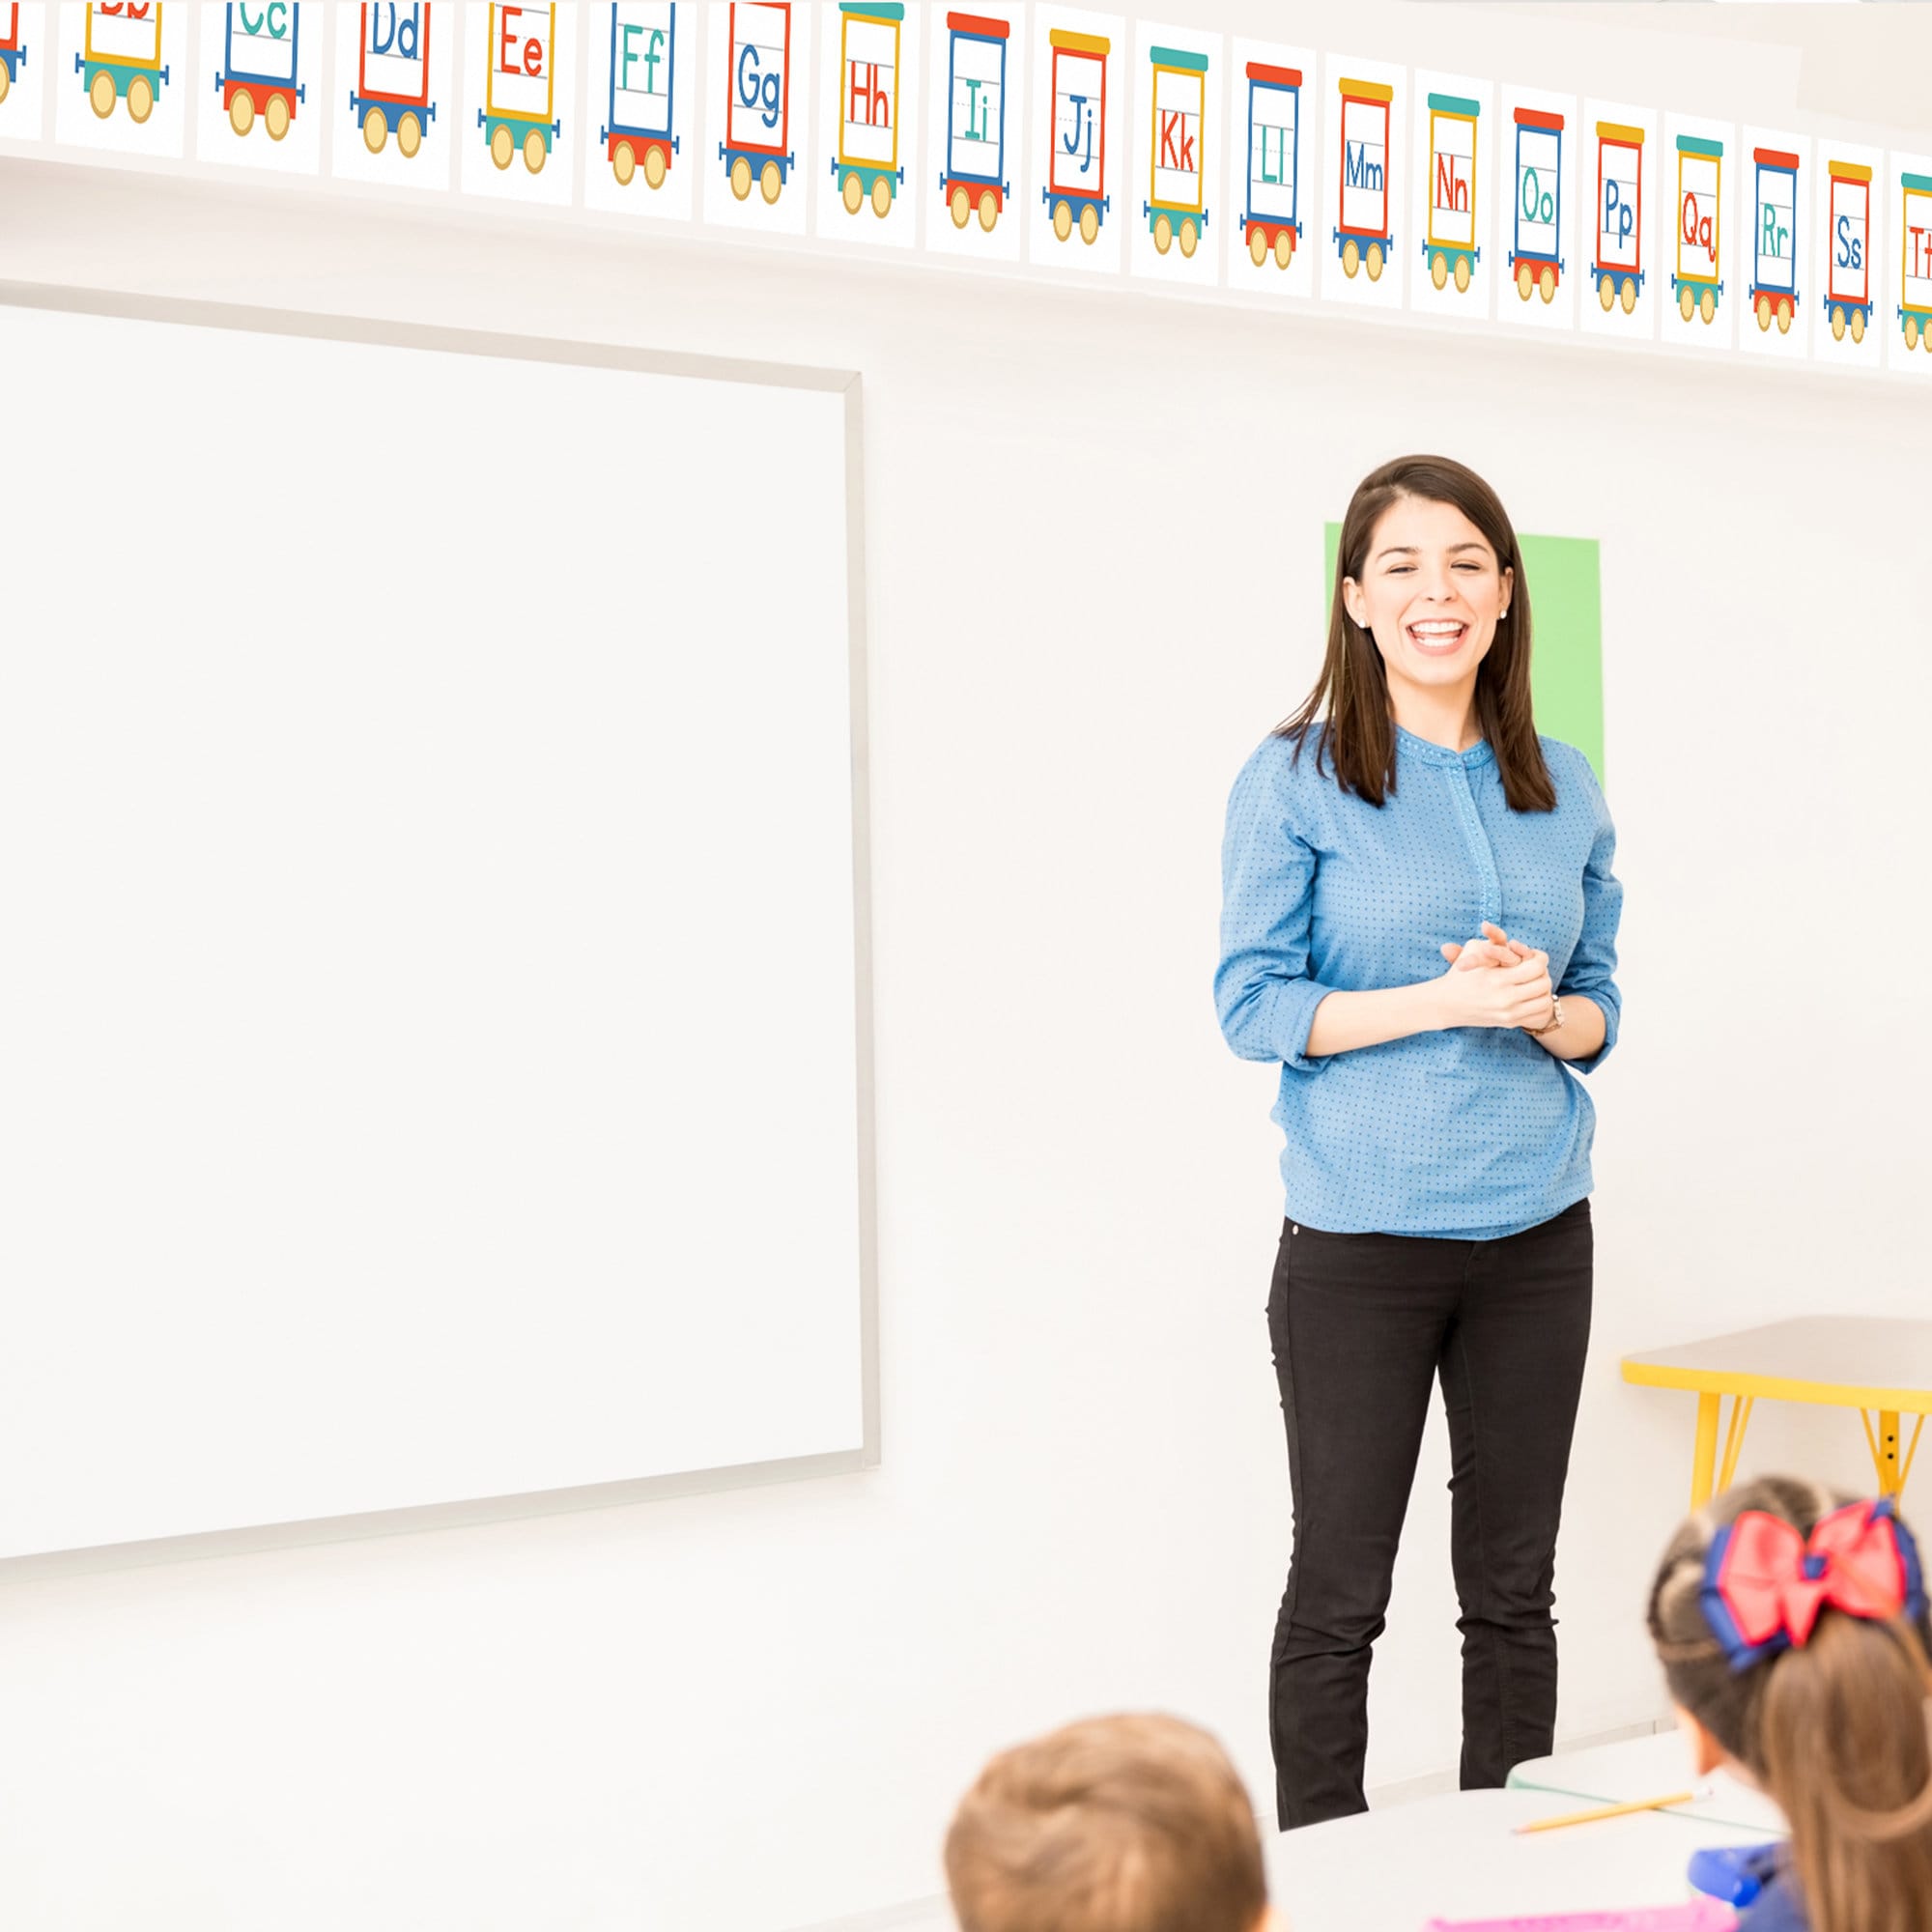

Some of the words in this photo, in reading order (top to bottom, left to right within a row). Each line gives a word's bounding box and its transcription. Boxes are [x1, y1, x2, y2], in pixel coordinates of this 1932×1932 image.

[372, 2, 419, 60] Dd
[499, 5, 543, 78] Ee
[622, 23, 665, 94] Ff
[738, 43, 781, 129] Gg
[849, 60, 890, 128] Hh
[964, 78, 988, 142] Ii
[1063, 94, 1093, 173] Jj
[1160, 108, 1195, 173] Kk
[1262, 125, 1284, 185] Ll
[1346, 141, 1383, 190] Mm
[1436, 153, 1468, 213] Nn
[1522, 166, 1554, 224] Oo
[1605, 179, 1634, 249] Pp
[1683, 191, 1717, 264] Qq
[1763, 203, 1789, 257] Rr
[1837, 215, 1861, 270] Ss
